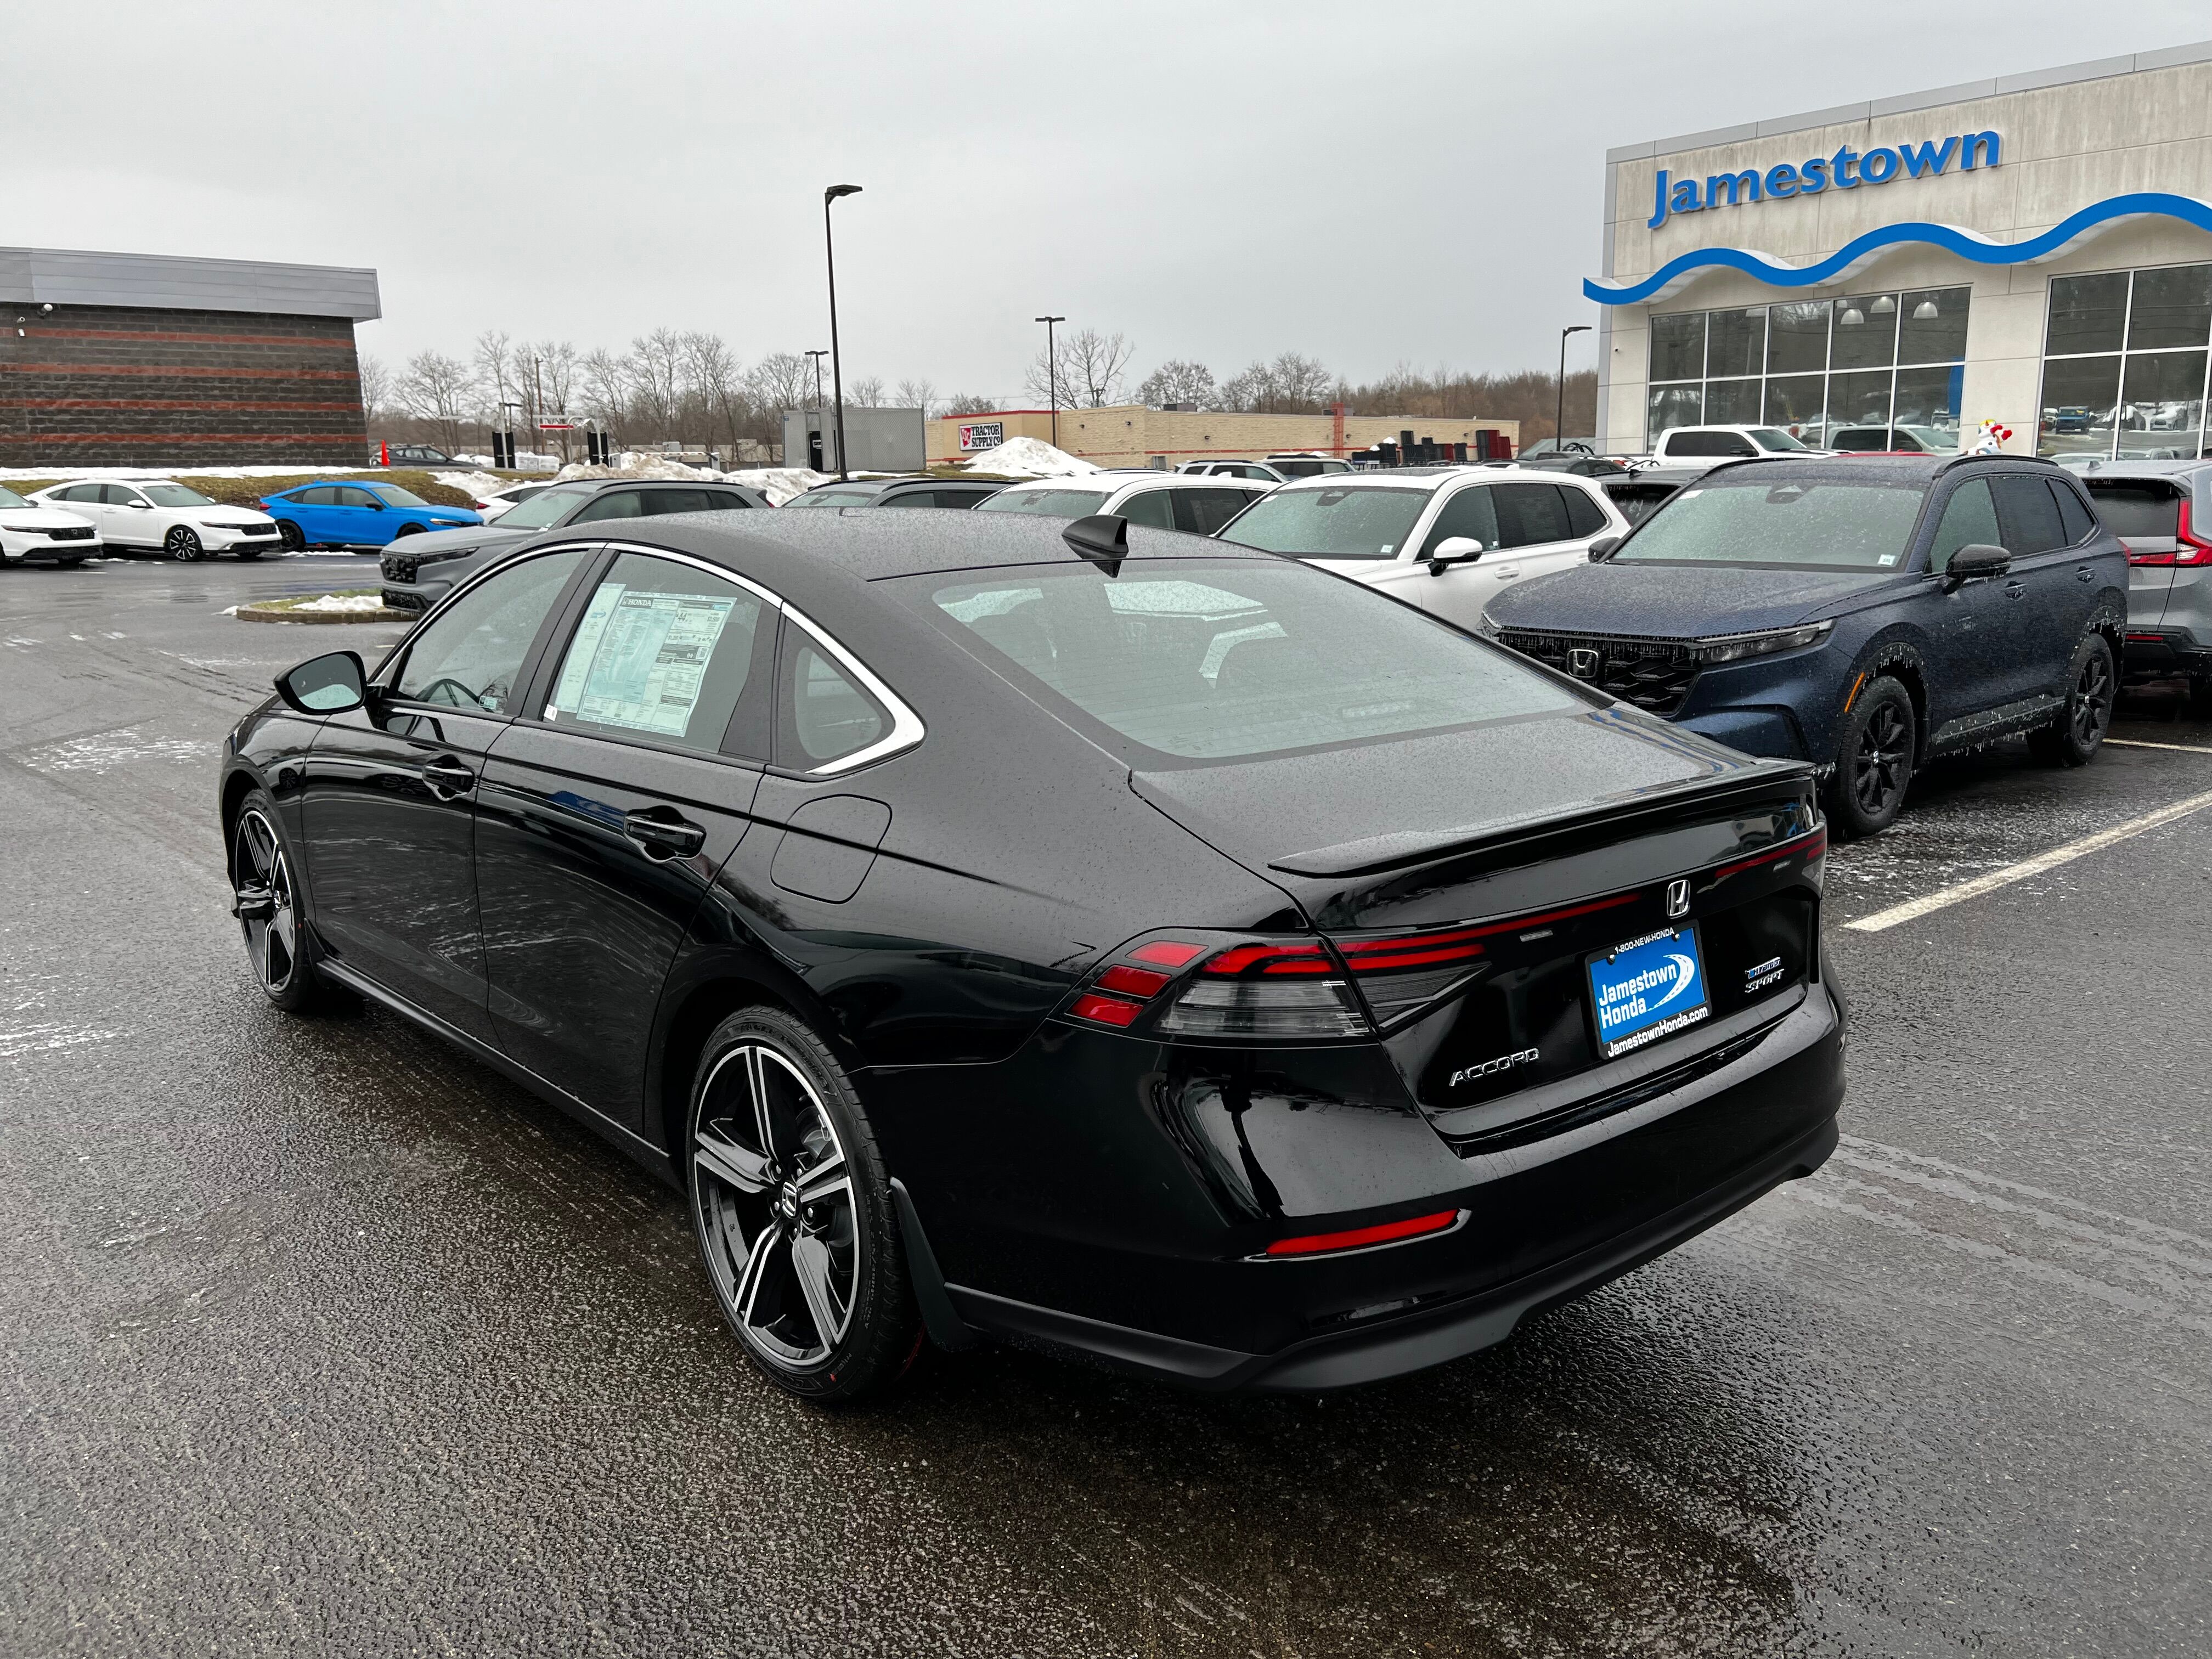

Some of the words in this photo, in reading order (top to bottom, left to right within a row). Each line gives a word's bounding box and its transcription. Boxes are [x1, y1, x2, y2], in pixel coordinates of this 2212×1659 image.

[1647, 130, 2004, 229] Jamestown
[961, 428, 970, 443] TSC
[972, 425, 1000, 436] TRACTOR
[972, 436, 993, 447] SUPPLY
[1599, 964, 1678, 1006] Jamestown
[1745, 968, 1785, 993] SPORT
[1600, 995, 1647, 1029] Honda
[1607, 1006, 1708, 1058] JamestownHonda.com
[1449, 1048, 1539, 1087] ACCORD
